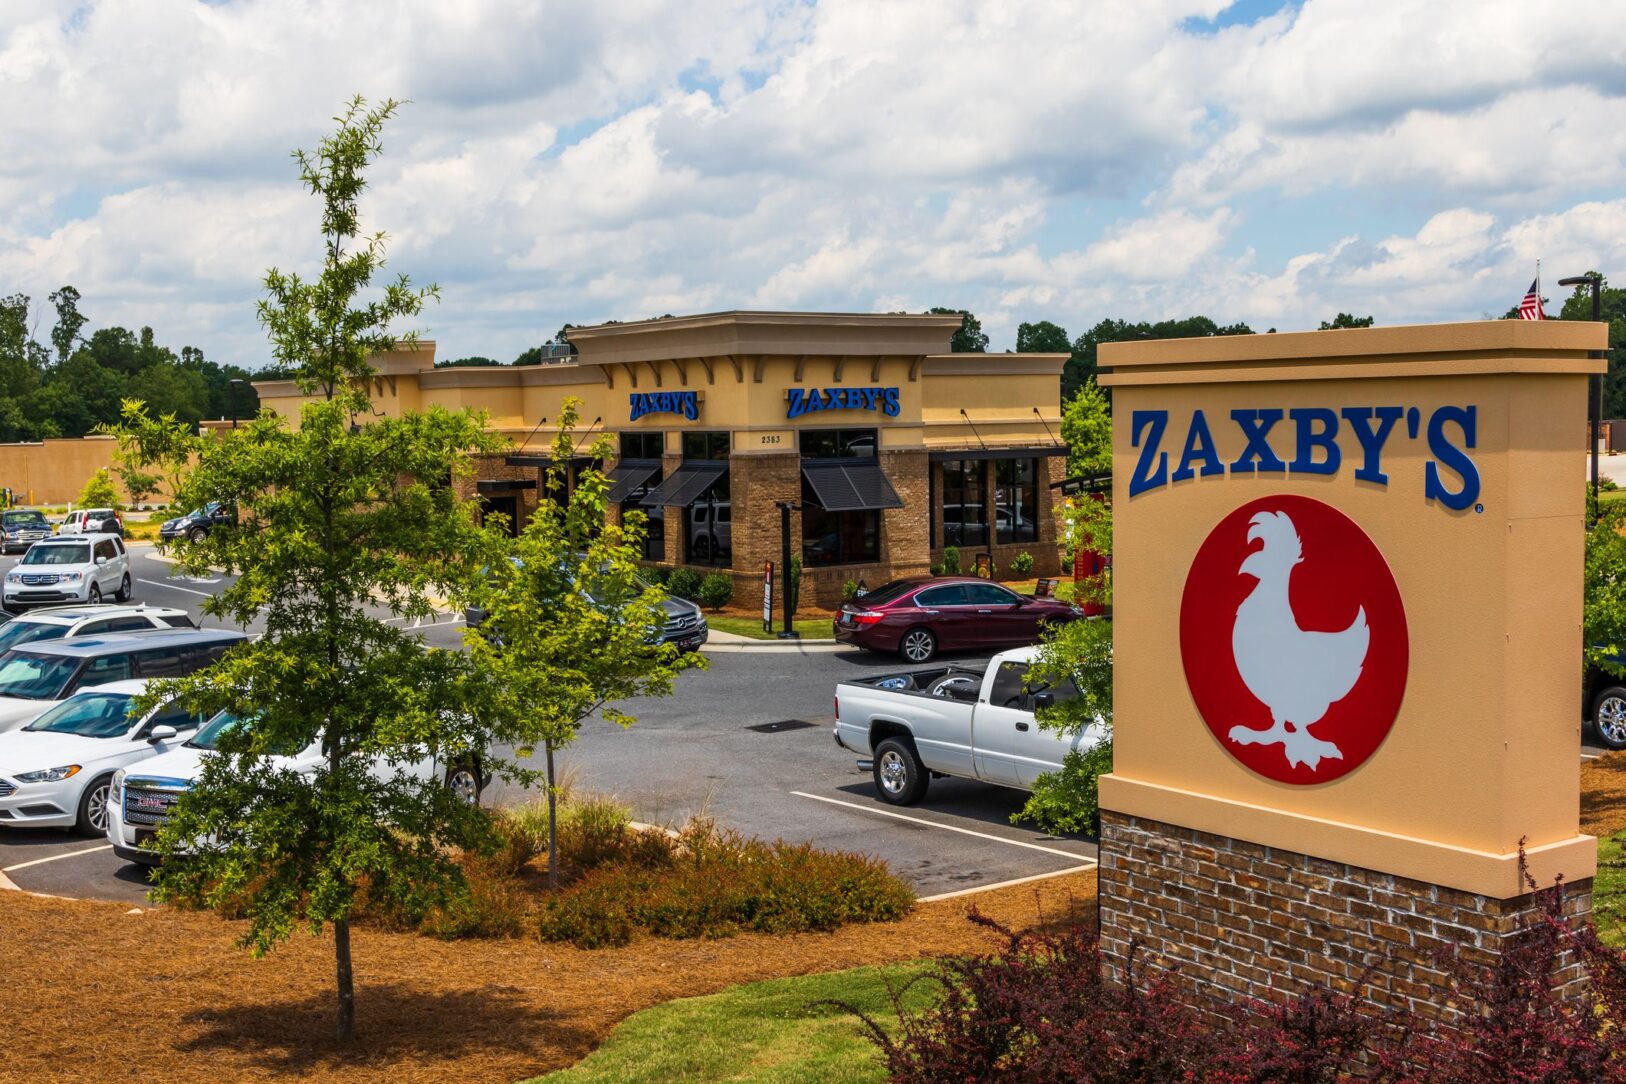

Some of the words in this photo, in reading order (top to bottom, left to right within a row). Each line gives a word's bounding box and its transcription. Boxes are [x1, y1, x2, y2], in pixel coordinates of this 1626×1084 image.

[630, 391, 698, 421] ZAXBY'S
[787, 387, 900, 419] ZAXBY'S
[1129, 405, 1482, 511] ZAXBY'S
[138, 797, 168, 809] GMC
